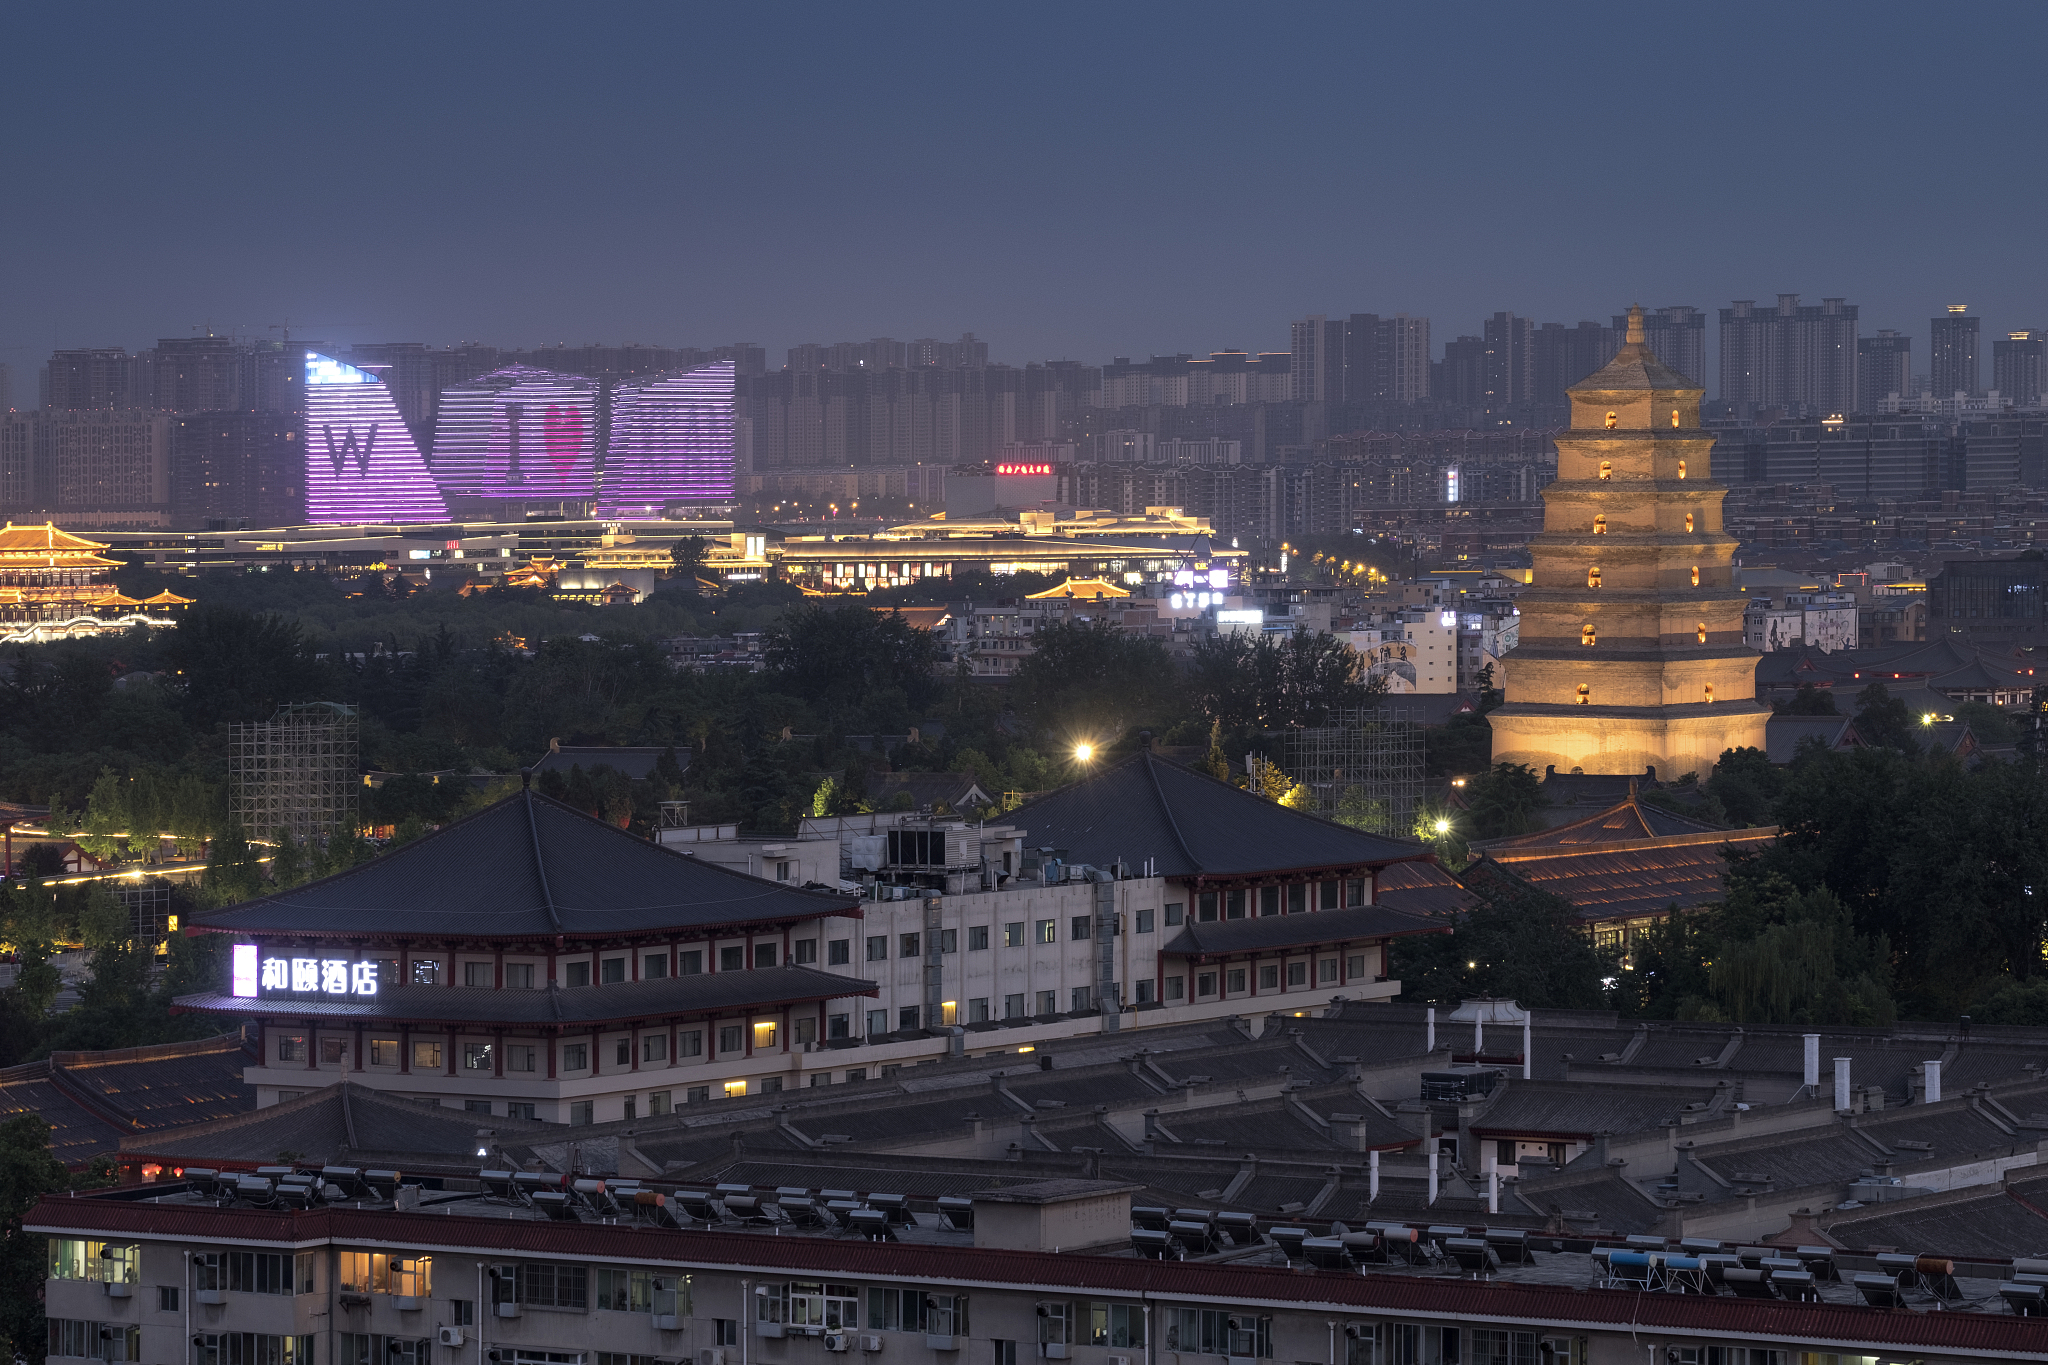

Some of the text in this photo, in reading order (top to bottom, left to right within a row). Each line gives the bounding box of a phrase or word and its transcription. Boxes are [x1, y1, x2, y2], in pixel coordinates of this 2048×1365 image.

[322, 424, 378, 480] W
[261, 957, 378, 995] 和颐酒店
